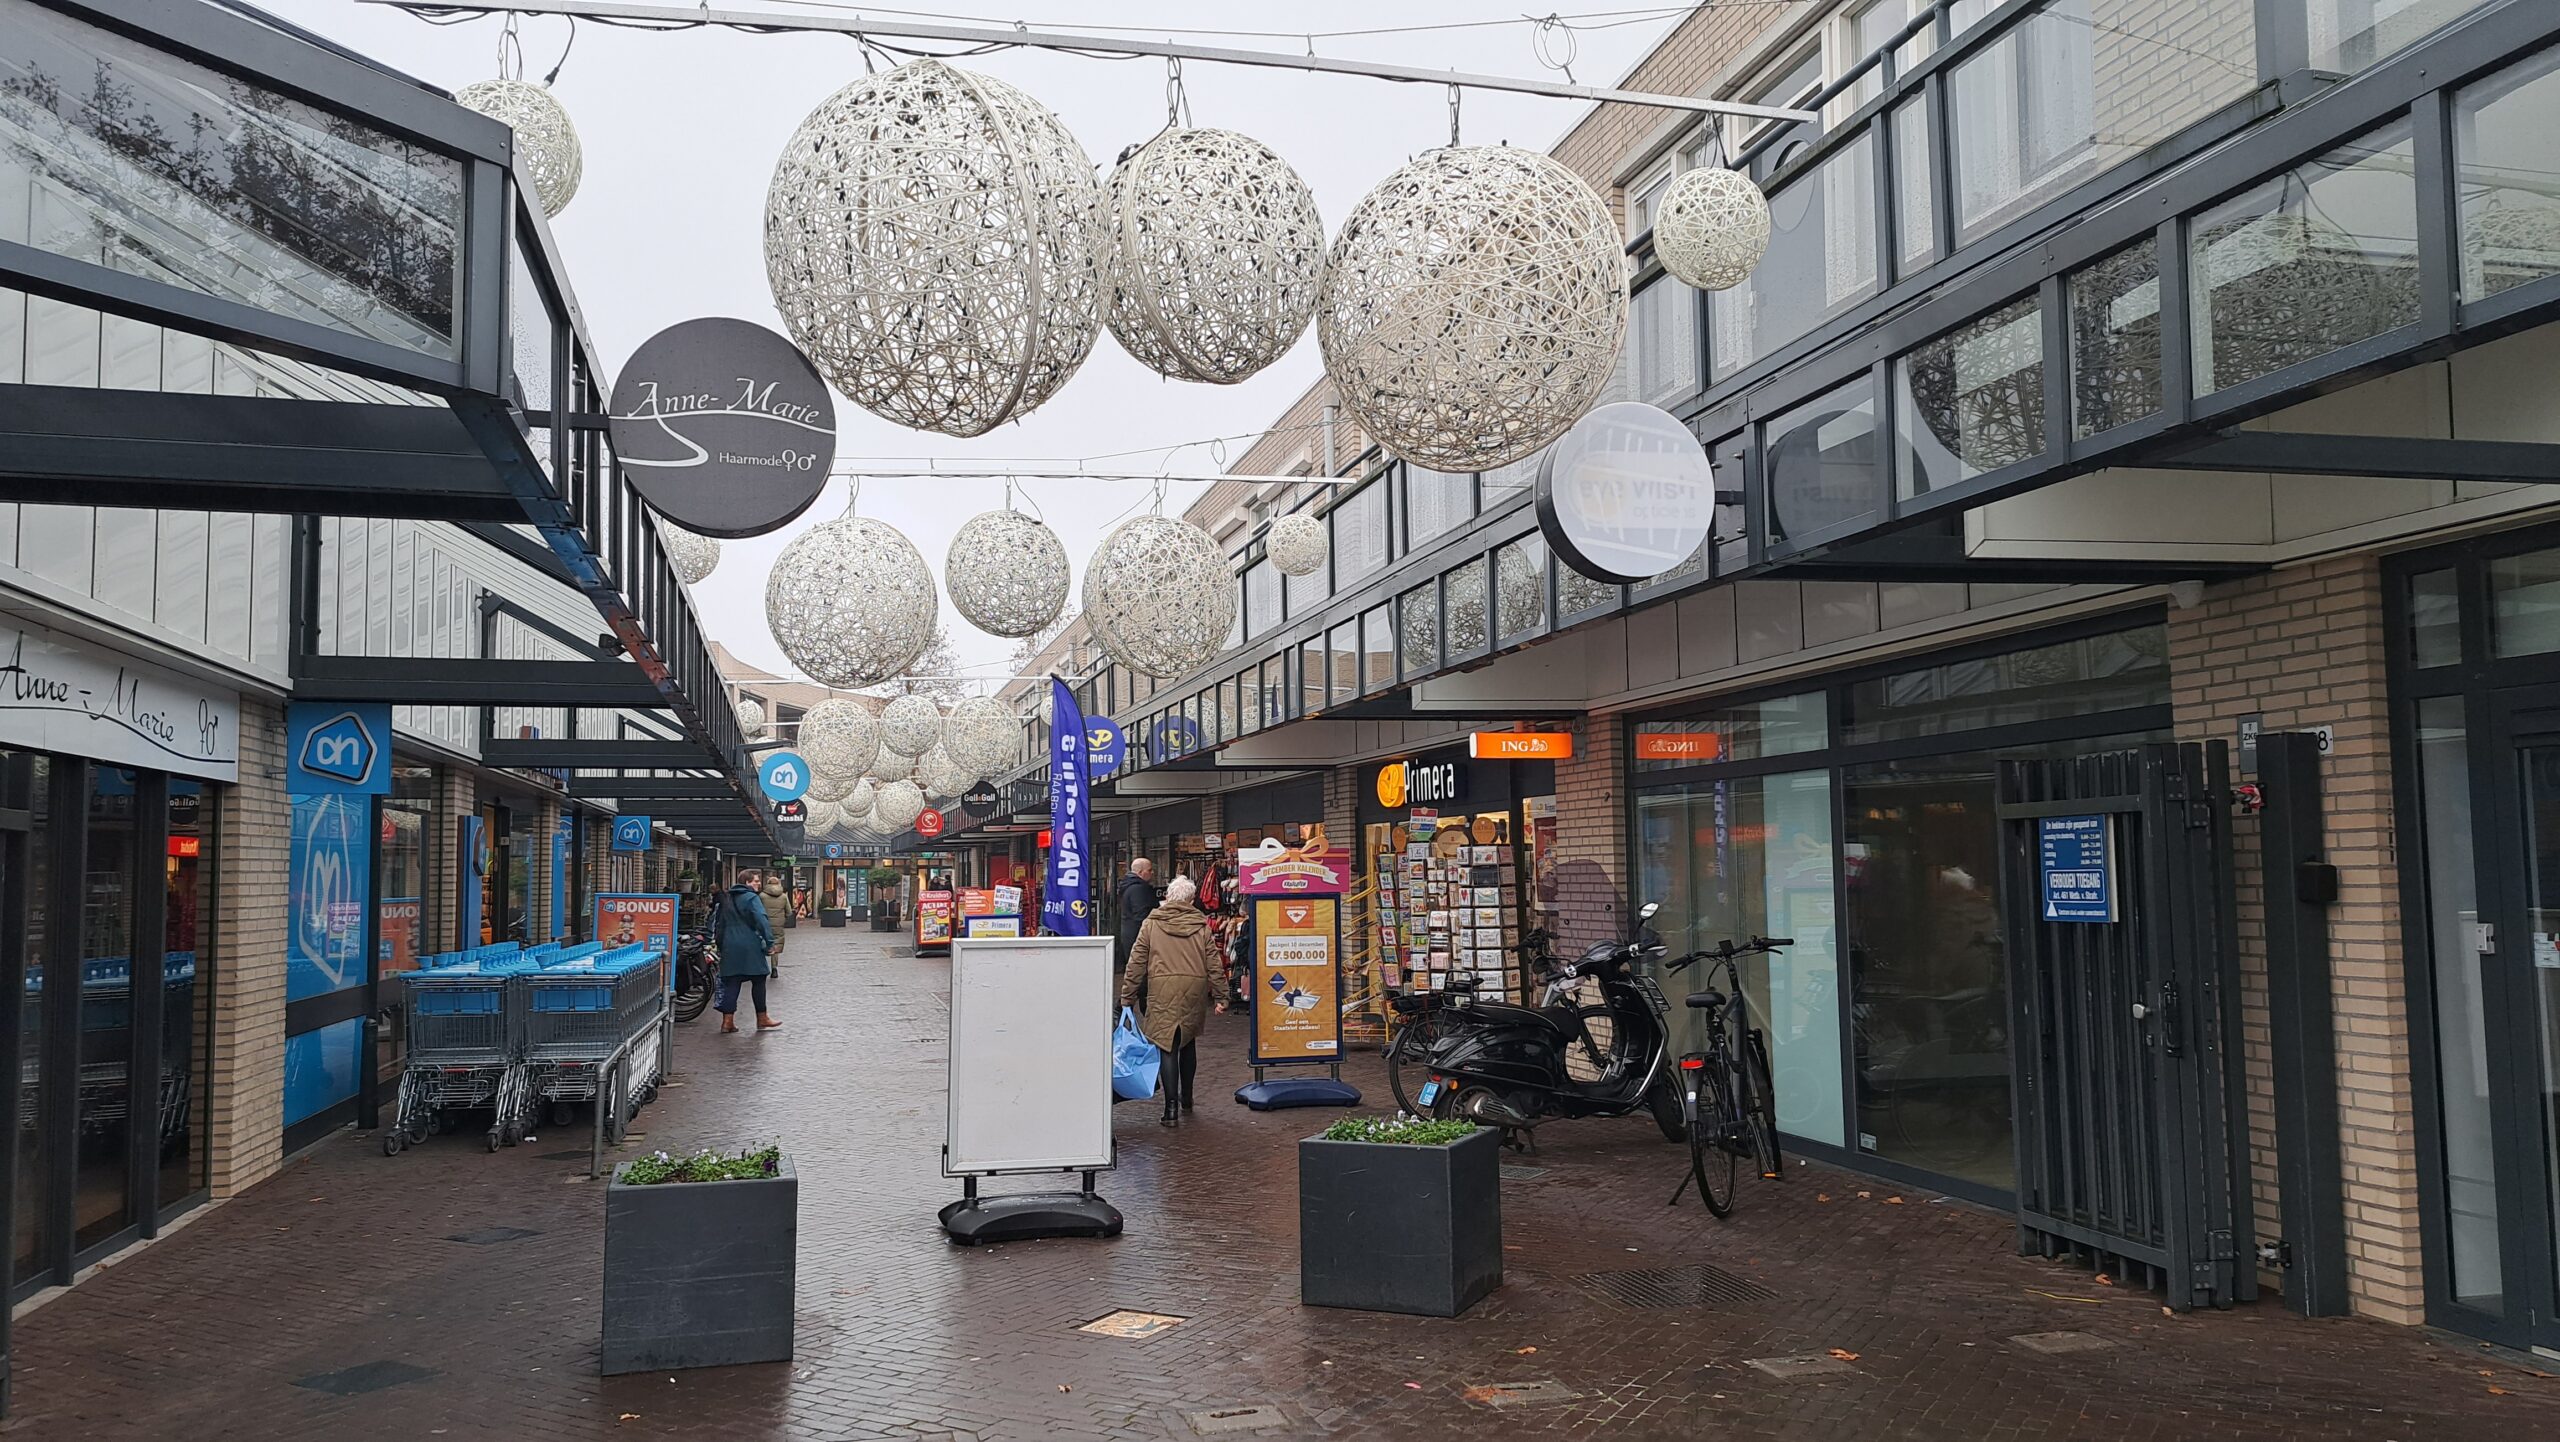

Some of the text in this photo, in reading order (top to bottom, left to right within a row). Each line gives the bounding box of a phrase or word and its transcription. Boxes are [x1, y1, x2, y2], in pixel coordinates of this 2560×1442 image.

[719, 452, 782, 467] Haarmode
[1501, 740, 1529, 752] ING
[1402, 758, 1455, 804] Primera
[777, 814, 804, 822] Sushi
[1262, 864, 1296, 877] DECEMBER
[2049, 872, 2101, 888] VERBODEN TOEGANG
[616, 901, 670, 913] BONUS
[1268, 950, 1326, 960] €7.500.000
